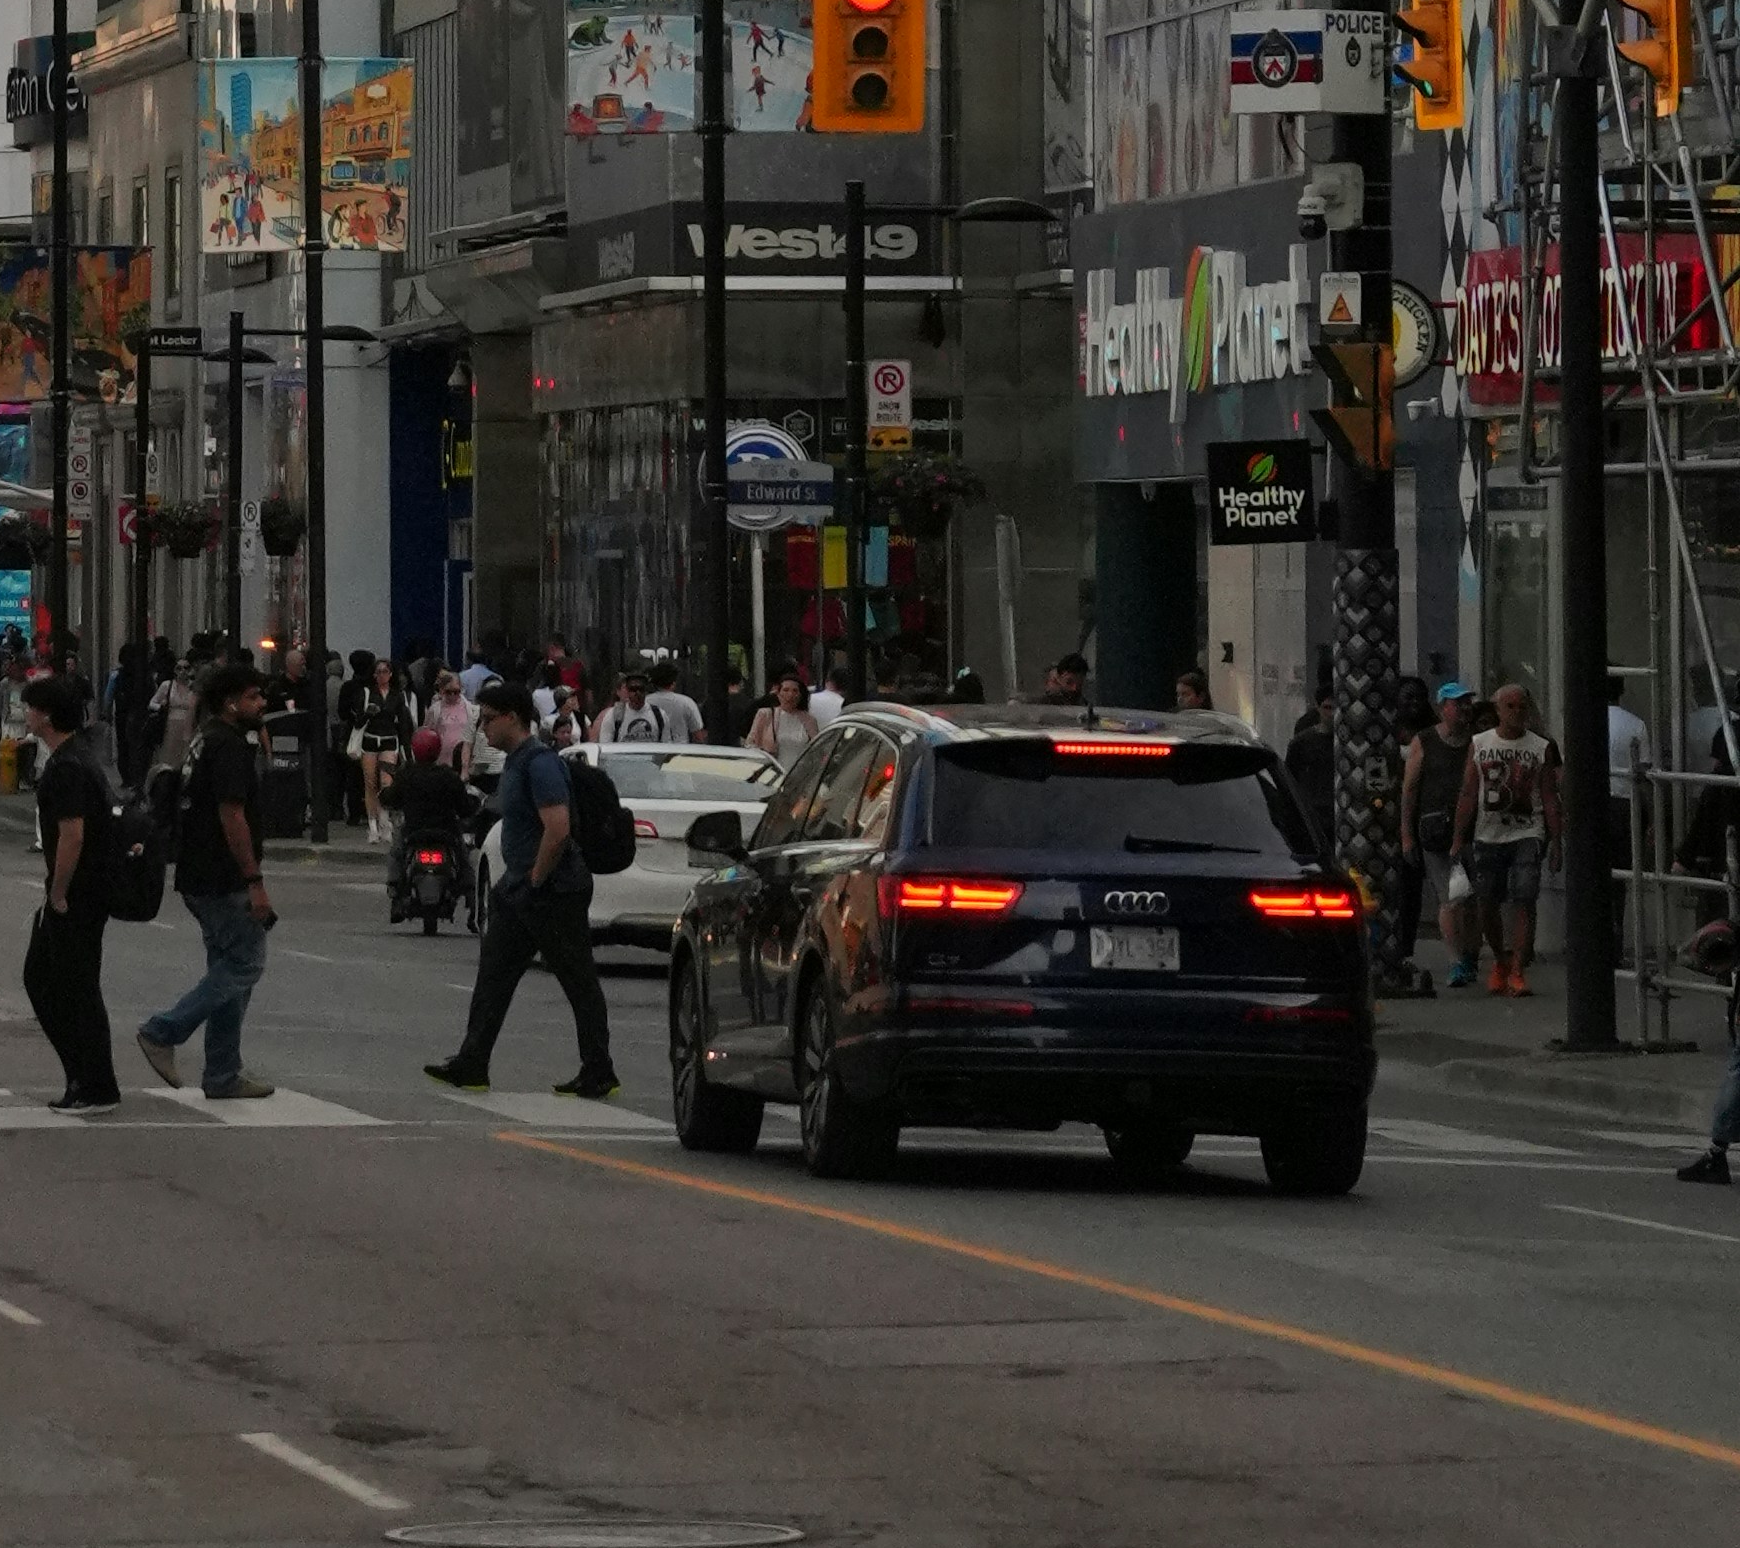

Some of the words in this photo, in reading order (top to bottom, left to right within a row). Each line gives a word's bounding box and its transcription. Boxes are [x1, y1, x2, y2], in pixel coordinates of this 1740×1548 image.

[1325, 13, 1383, 35] POLICE
[1086, 265, 1186, 424] Healthy
[1211, 242, 1313, 387] Planet
[1455, 273, 1523, 377] DAVE'S
[160, 334, 198, 346] Locker
[746, 483, 801, 501] Edward
[803, 488, 817, 501] St
[1218, 485, 1306, 511] Healthy
[1224, 504, 1299, 528] Planet
